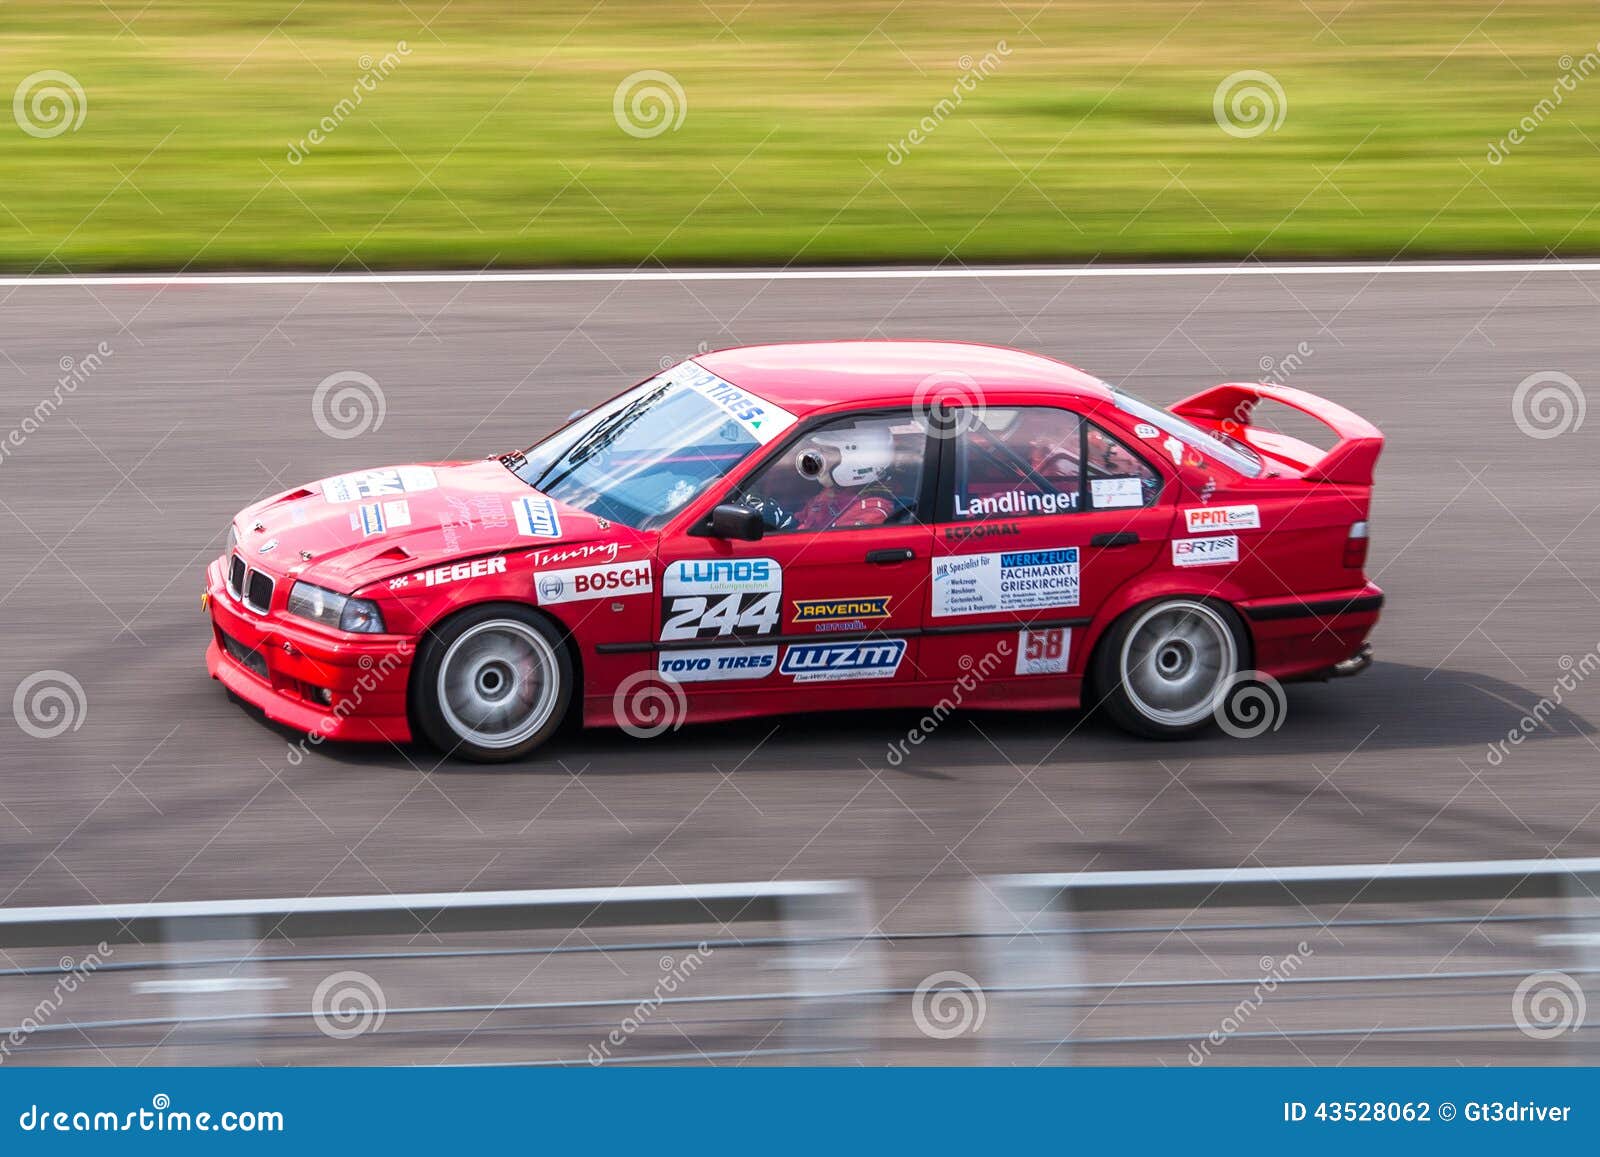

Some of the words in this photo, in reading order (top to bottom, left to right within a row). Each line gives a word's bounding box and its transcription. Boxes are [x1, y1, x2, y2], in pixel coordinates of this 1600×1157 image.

[706, 382, 765, 421] TIRES
[954, 490, 1080, 515] Landlinger
[1190, 510, 1229, 526] PPM
[1176, 540, 1216, 554] BRT
[949, 557, 980, 574] Spezialist
[1001, 550, 1077, 567] WERKZEUG
[574, 567, 650, 593] BOSCH
[680, 561, 770, 583] LUNOS
[1000, 564, 1073, 581] FACHMARKT
[1000, 576, 1079, 593] GRIESKIRCHEN
[660, 591, 782, 641] 244
[803, 602, 881, 616] RAVENOL
[1025, 629, 1064, 662] 58
[661, 658, 711, 672] TOYO
[718, 655, 774, 669] TIRES
